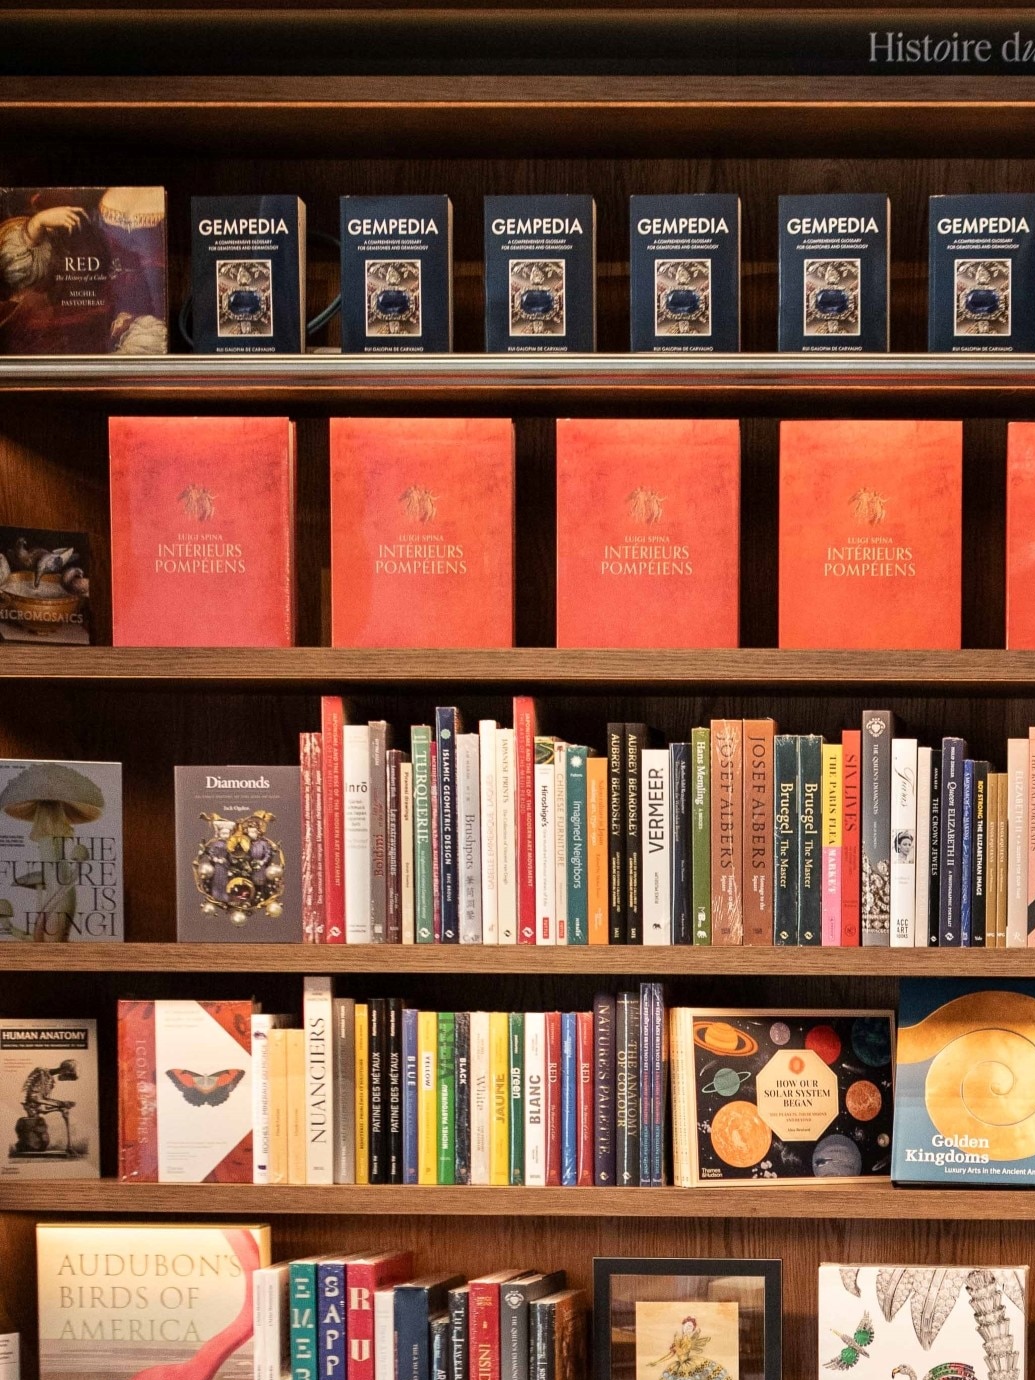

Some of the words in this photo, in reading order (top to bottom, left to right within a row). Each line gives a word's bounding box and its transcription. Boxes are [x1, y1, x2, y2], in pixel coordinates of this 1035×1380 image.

[868, 32, 991, 63] Histoire
[199, 219, 288, 235] GEMPEDIA
[348, 219, 438, 235] GEMPEDIA
[492, 219, 582, 235] GEMPEDIA
[638, 218, 728, 234] GEMPEDIA
[787, 218, 878, 234] GEMPEDIA
[938, 218, 1029, 234] GEMPEDIA
[65, 257, 100, 271] RED
[158, 541, 242, 558] INTÉRIEURS
[378, 541, 463, 559] INTÉRIEURS
[604, 542, 689, 559] INTÉRIEURS
[827, 543, 913, 561] INTÉRIEURS
[155, 558, 246, 574] POMPÉIENS
[375, 558, 466, 575] POMPÉIENS
[601, 558, 692, 575] POMPÉIENS
[824, 559, 916, 577] POMPÉIENS
[611, 733, 620, 775] AUBREY
[628, 733, 638, 775] AUBREY
[695, 742, 705, 765] Hans
[716, 736, 734, 793] JOSEF
[748, 737, 766, 794] JOSEF
[845, 755, 857, 779] SIX
[206, 776, 270, 789] Diamonds
[695, 767, 706, 806] Memling
[413, 750, 428, 844] TURQUERIE
[443, 784, 451, 832] GEOMETRIC
[611, 778, 621, 837] BEARDSLEY
[628, 778, 638, 837] BEARDSLEY
[776, 783, 793, 833] Bruegel
[800, 783, 818, 833] Bruegel
[845, 786, 857, 832] LIVES
[570, 801, 582, 841] Imagined
[648, 768, 664, 854] VERMEER
[464, 814, 475, 869] Brushpots
[720, 798, 734, 869] ALBERS
[752, 798, 766, 869] ALBERS
[53, 837, 116, 861] THE
[781, 840, 789, 856] The
[805, 840, 813, 856] The
[573, 843, 582, 889] Neighbors
[781, 857, 789, 888] Master
[805, 857, 813, 889] Master
[91, 887, 116, 911] IS
[24, 911, 118, 936] FUNGI
[372, 1052, 381, 1085] MÉTAUX
[391, 1052, 400, 1085] MÉTAUX
[407, 1056, 416, 1087] BLUE
[459, 1057, 467, 1085] BLACK
[617, 1051, 626, 1068] OF
[310, 1017, 326, 1144] NUANCIERS
[511, 1068, 521, 1099] green
[549, 1062, 558, 1083] RED
[581, 1062, 589, 1083] RED
[776, 1080, 796, 1088] HOW
[372, 1086, 381, 1101] DES
[390, 1086, 400, 1101] DES
[496, 1074, 505, 1123] JAUNE
[529, 1075, 541, 1124] BLANC
[617, 1072, 626, 1128] COLOUR
[627, 1072, 637, 1138] ANATOMY
[764, 1089, 793, 1097] SOLAR
[795, 1089, 830, 1097] SYSTEM
[783, 1099, 813, 1107] BEGAN
[372, 1102, 381, 1133] PATINE
[390, 1102, 400, 1133] PATINE
[932, 1134, 989, 1148] Golden
[905, 1149, 989, 1165] Kingdoms
[945, 1167, 966, 1175] Luxury
[57, 1254, 241, 1277] AUDUBON'S
[59, 1286, 151, 1310] BIRDS
[159, 1286, 200, 1309] OF
[59, 1319, 202, 1343] AMERICA
